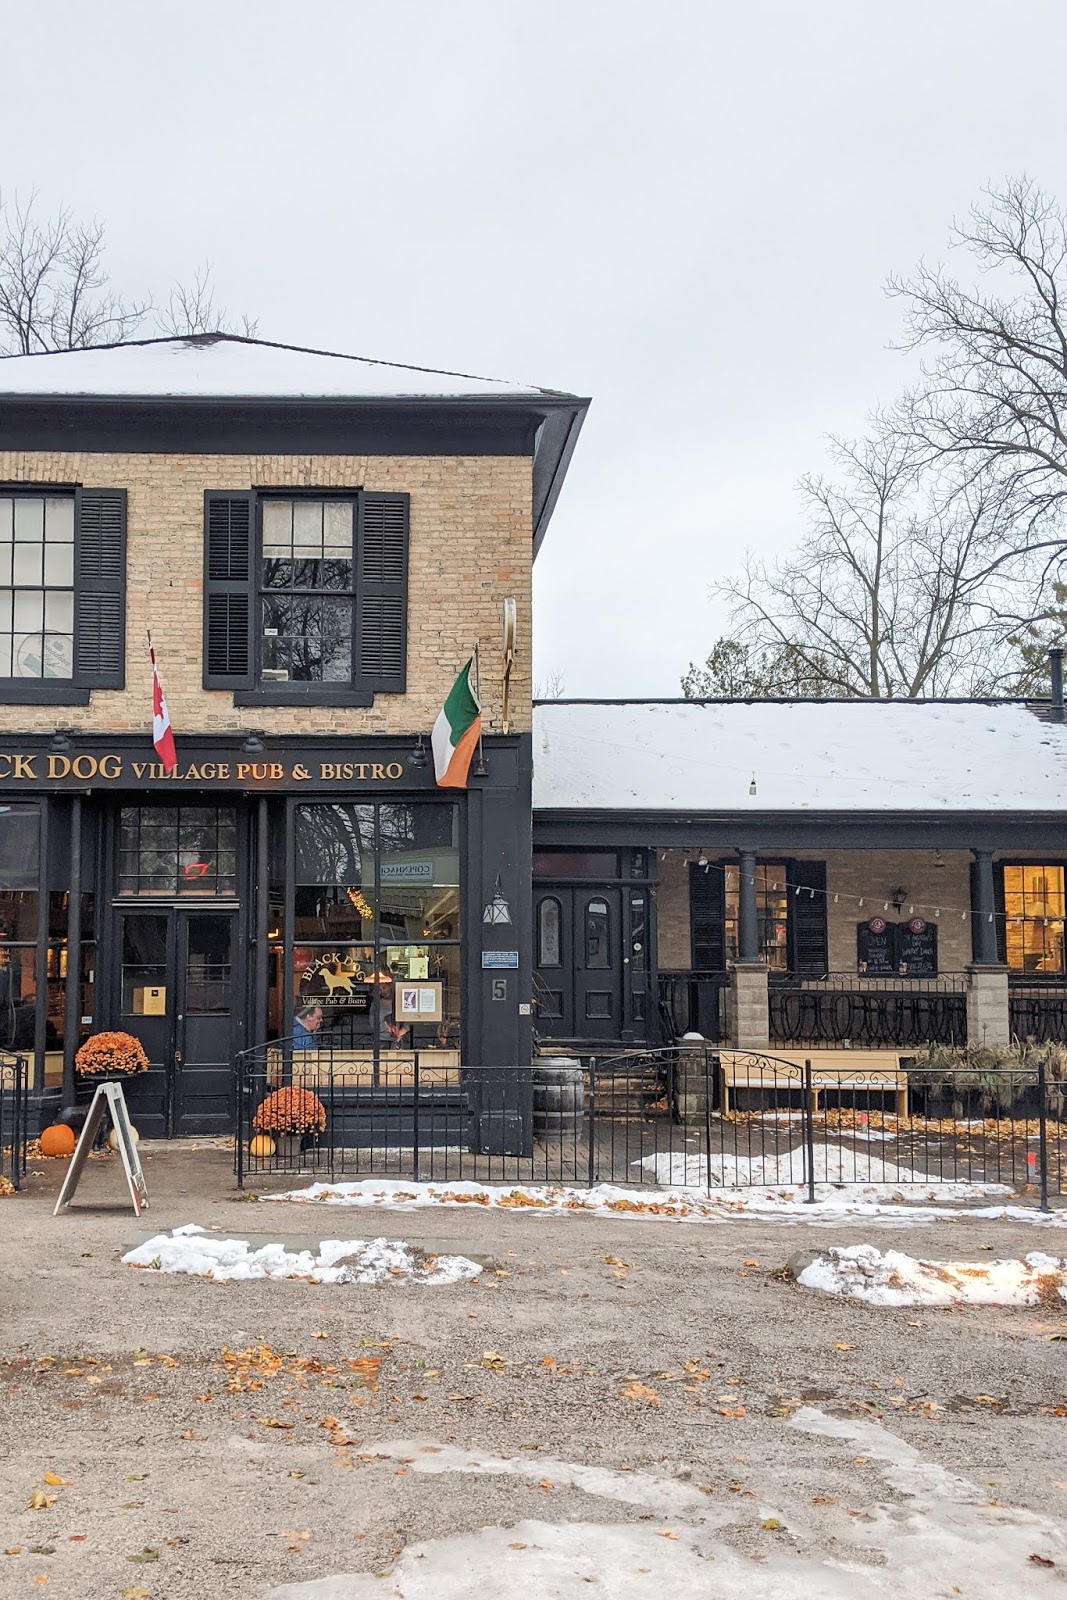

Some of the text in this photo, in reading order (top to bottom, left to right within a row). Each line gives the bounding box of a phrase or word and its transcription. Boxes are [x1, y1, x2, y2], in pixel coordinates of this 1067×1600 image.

[46, 754, 123, 779] DOG
[131, 762, 230, 780] VILLAGE
[236, 763, 284, 780] PUB
[291, 763, 312, 780] &
[320, 762, 403, 780] BISTRO
[302, 952, 366, 981] BLACK DOG
[494, 980, 505, 999] 5
[302, 997, 367, 1006] Village Pub & Bistro
